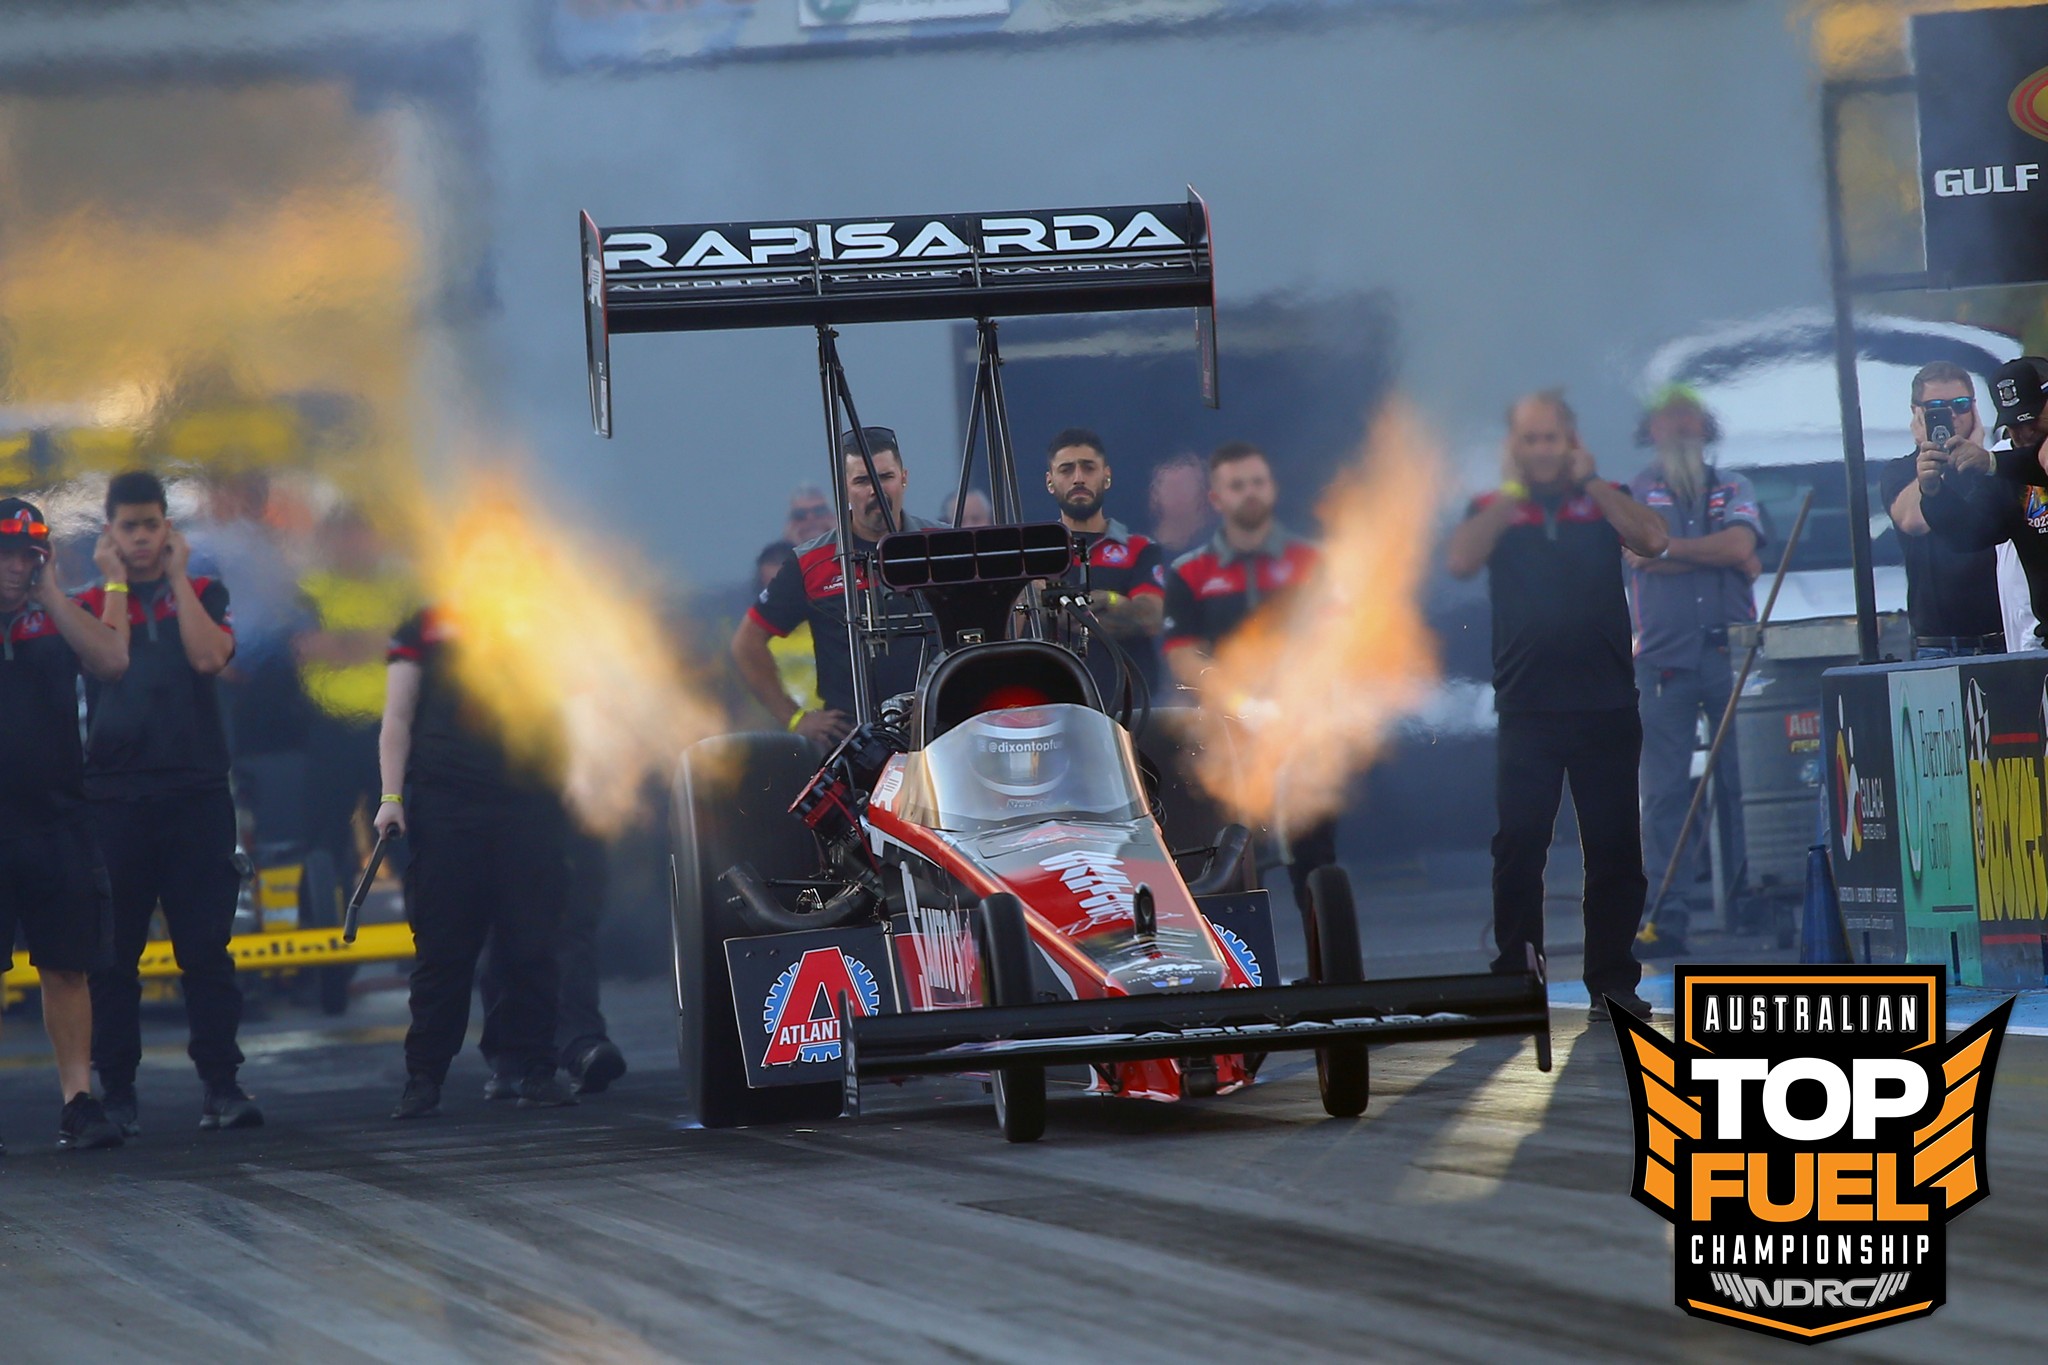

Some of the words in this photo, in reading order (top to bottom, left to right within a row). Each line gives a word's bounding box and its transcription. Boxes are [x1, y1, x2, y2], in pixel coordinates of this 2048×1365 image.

[1934, 164, 2039, 197] GULF
[603, 210, 1185, 269] RAPISARDA
[988, 739, 1063, 754] @dixontopfu
[778, 1019, 841, 1046] ATLANT
